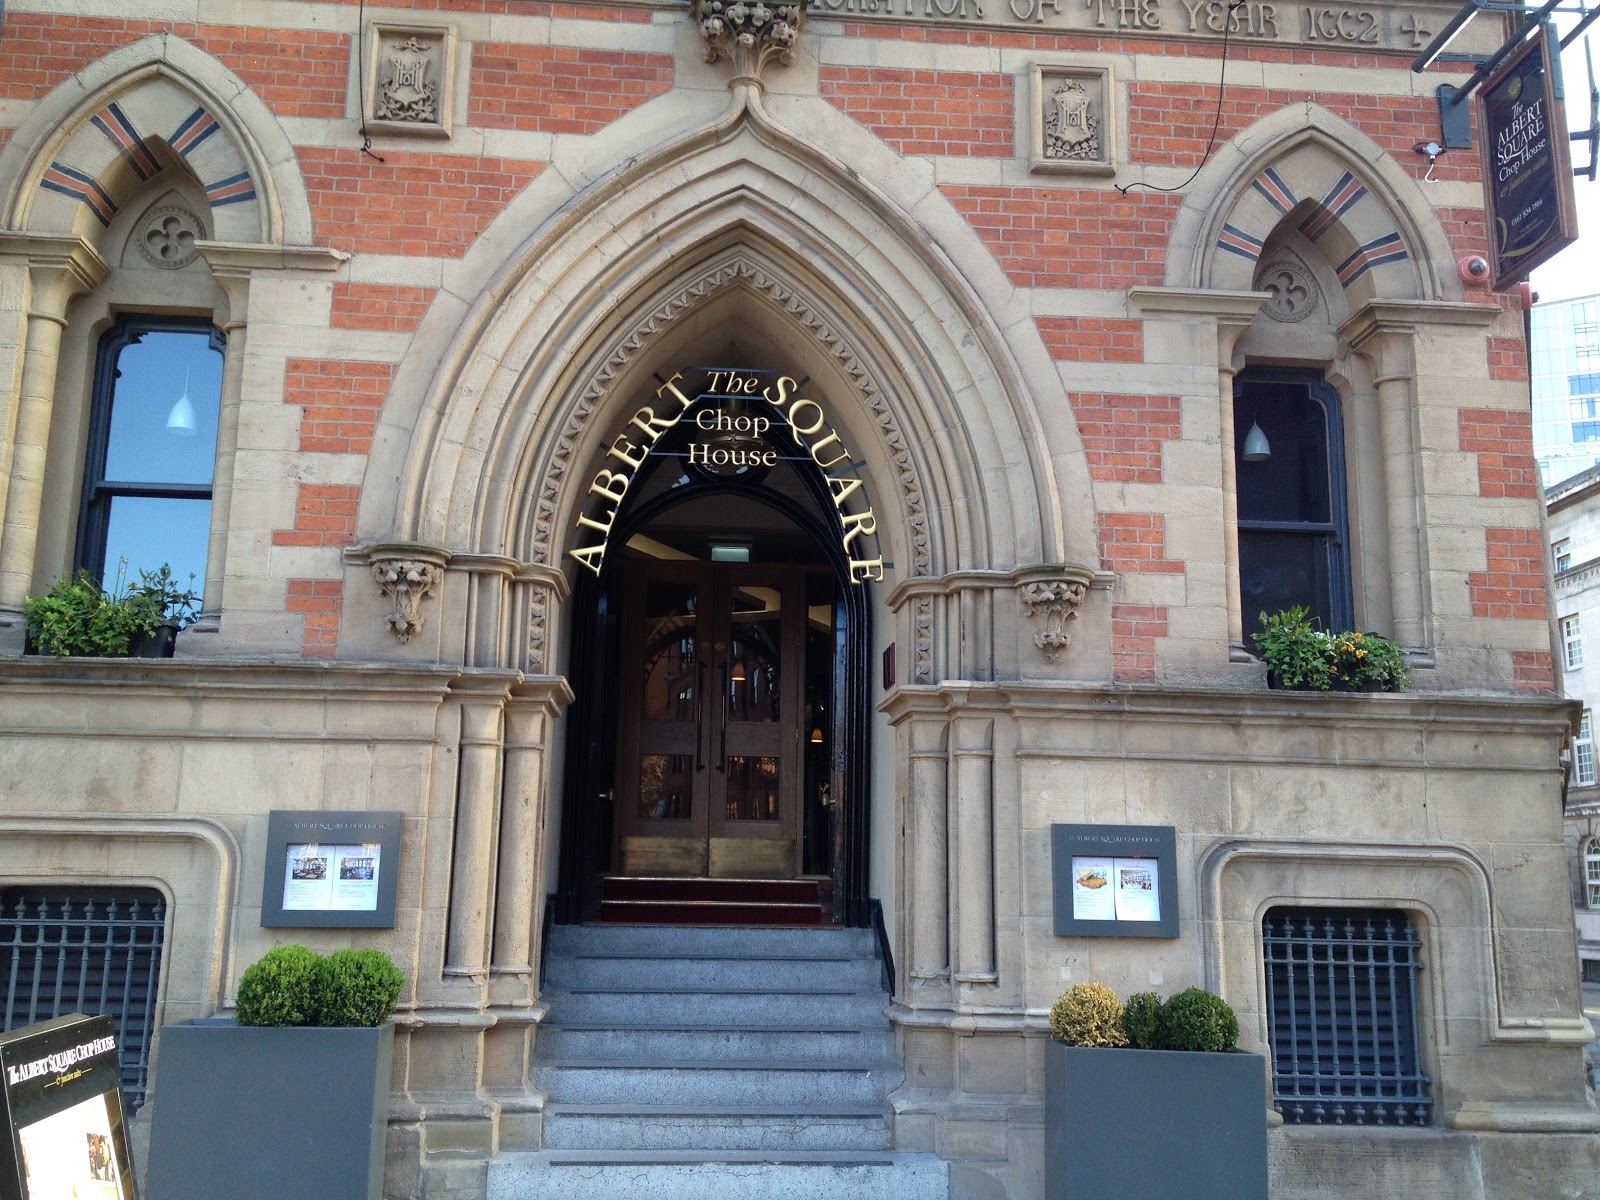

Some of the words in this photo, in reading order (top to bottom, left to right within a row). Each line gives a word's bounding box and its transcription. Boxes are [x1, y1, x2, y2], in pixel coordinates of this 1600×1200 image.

[1086, 0, 1160, 30] THE
[1180, 0, 1279, 38] YEAR
[1497, 98, 1542, 150] ALBERT
[1511, 101, 1524, 120] The
[1497, 115, 1545, 166] SQUARE
[1499, 161, 1520, 182] Chop
[1521, 138, 1546, 165] House
[706, 371, 759, 394] The
[695, 408, 770, 441] Chop
[687, 443, 778, 467] House
[568, 372, 695, 578] ALBERT
[763, 376, 886, 585] SQUARE
[19, 1057, 49, 1082] ALBERT
[47, 1048, 78, 1073] SQUARE
[76, 1042, 94, 1061] CHOP
[93, 1035, 116, 1056] HOUSE
